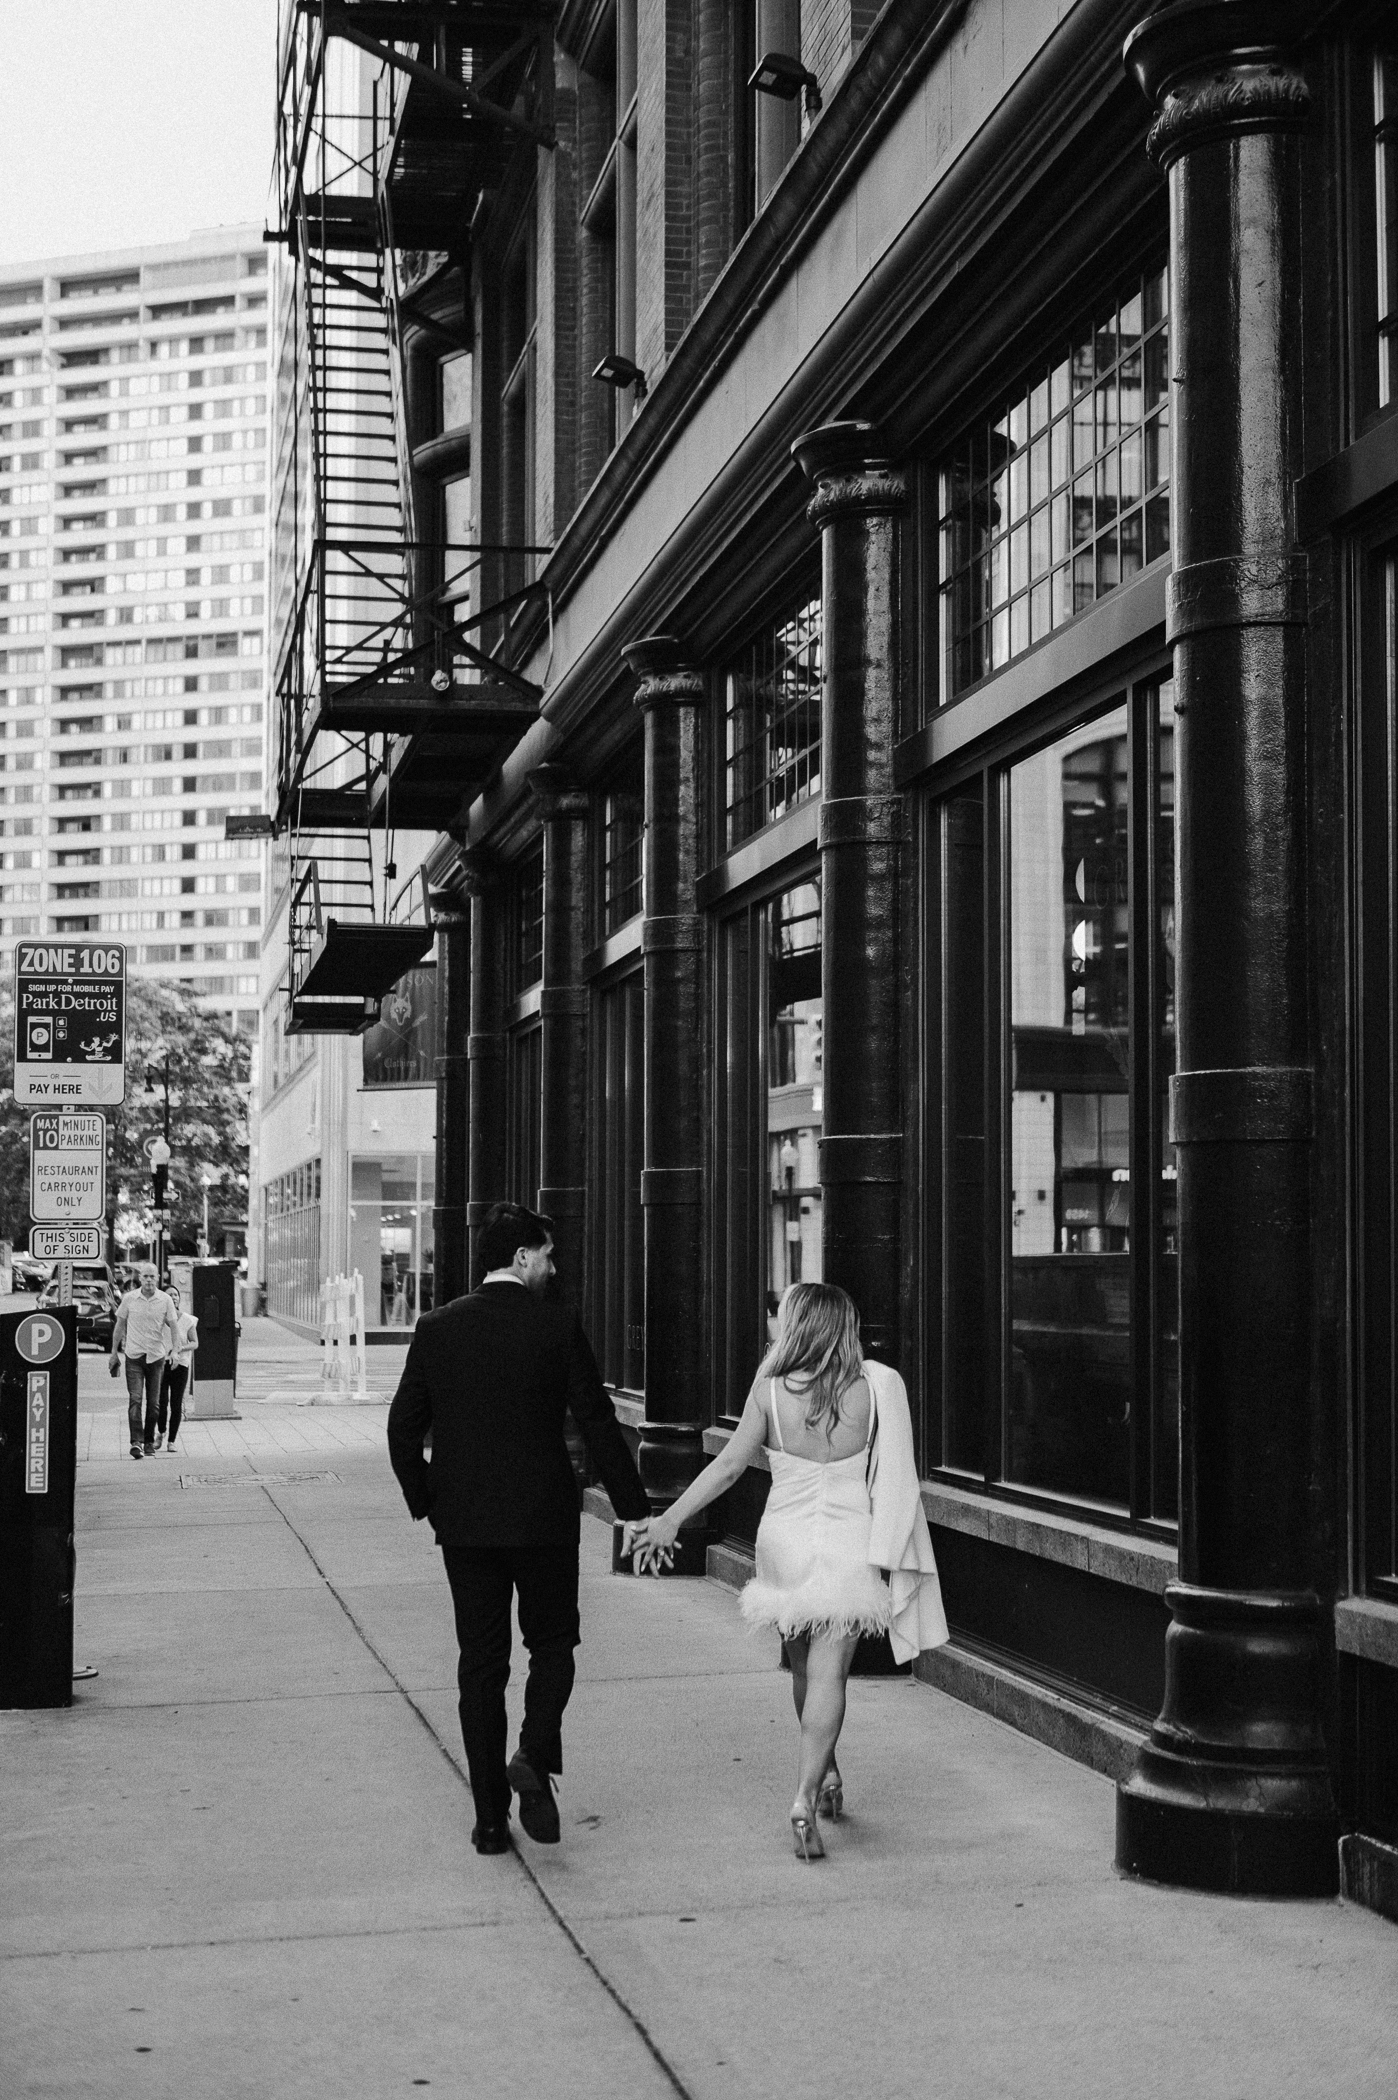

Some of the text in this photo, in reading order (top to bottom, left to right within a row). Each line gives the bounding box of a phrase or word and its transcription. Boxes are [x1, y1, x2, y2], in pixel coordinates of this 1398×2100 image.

[20, 947, 121, 974] ZONE 106
[28, 984, 115, 993] SIGN UP FOR MOBILE PAY
[96, 1012, 117, 1022] .US
[29, 1084, 82, 1094] PAY HERE
[36, 1118, 58, 1129] MAX
[62, 1119, 97, 1132] MINUTE
[38, 1130, 58, 1148] 10
[60, 1134, 100, 1146] PARKING
[37, 1165, 99, 1176] RESTAURANT
[40, 1182, 94, 1192] CARRYOUT
[56, 1197, 83, 1207] ONLY
[39, 1232, 94, 1243] THIS SIDE
[44, 1244, 90, 1255] OF SIGN
[31, 1323, 53, 1356] P
[30, 1376, 46, 1488] PAY HERE
